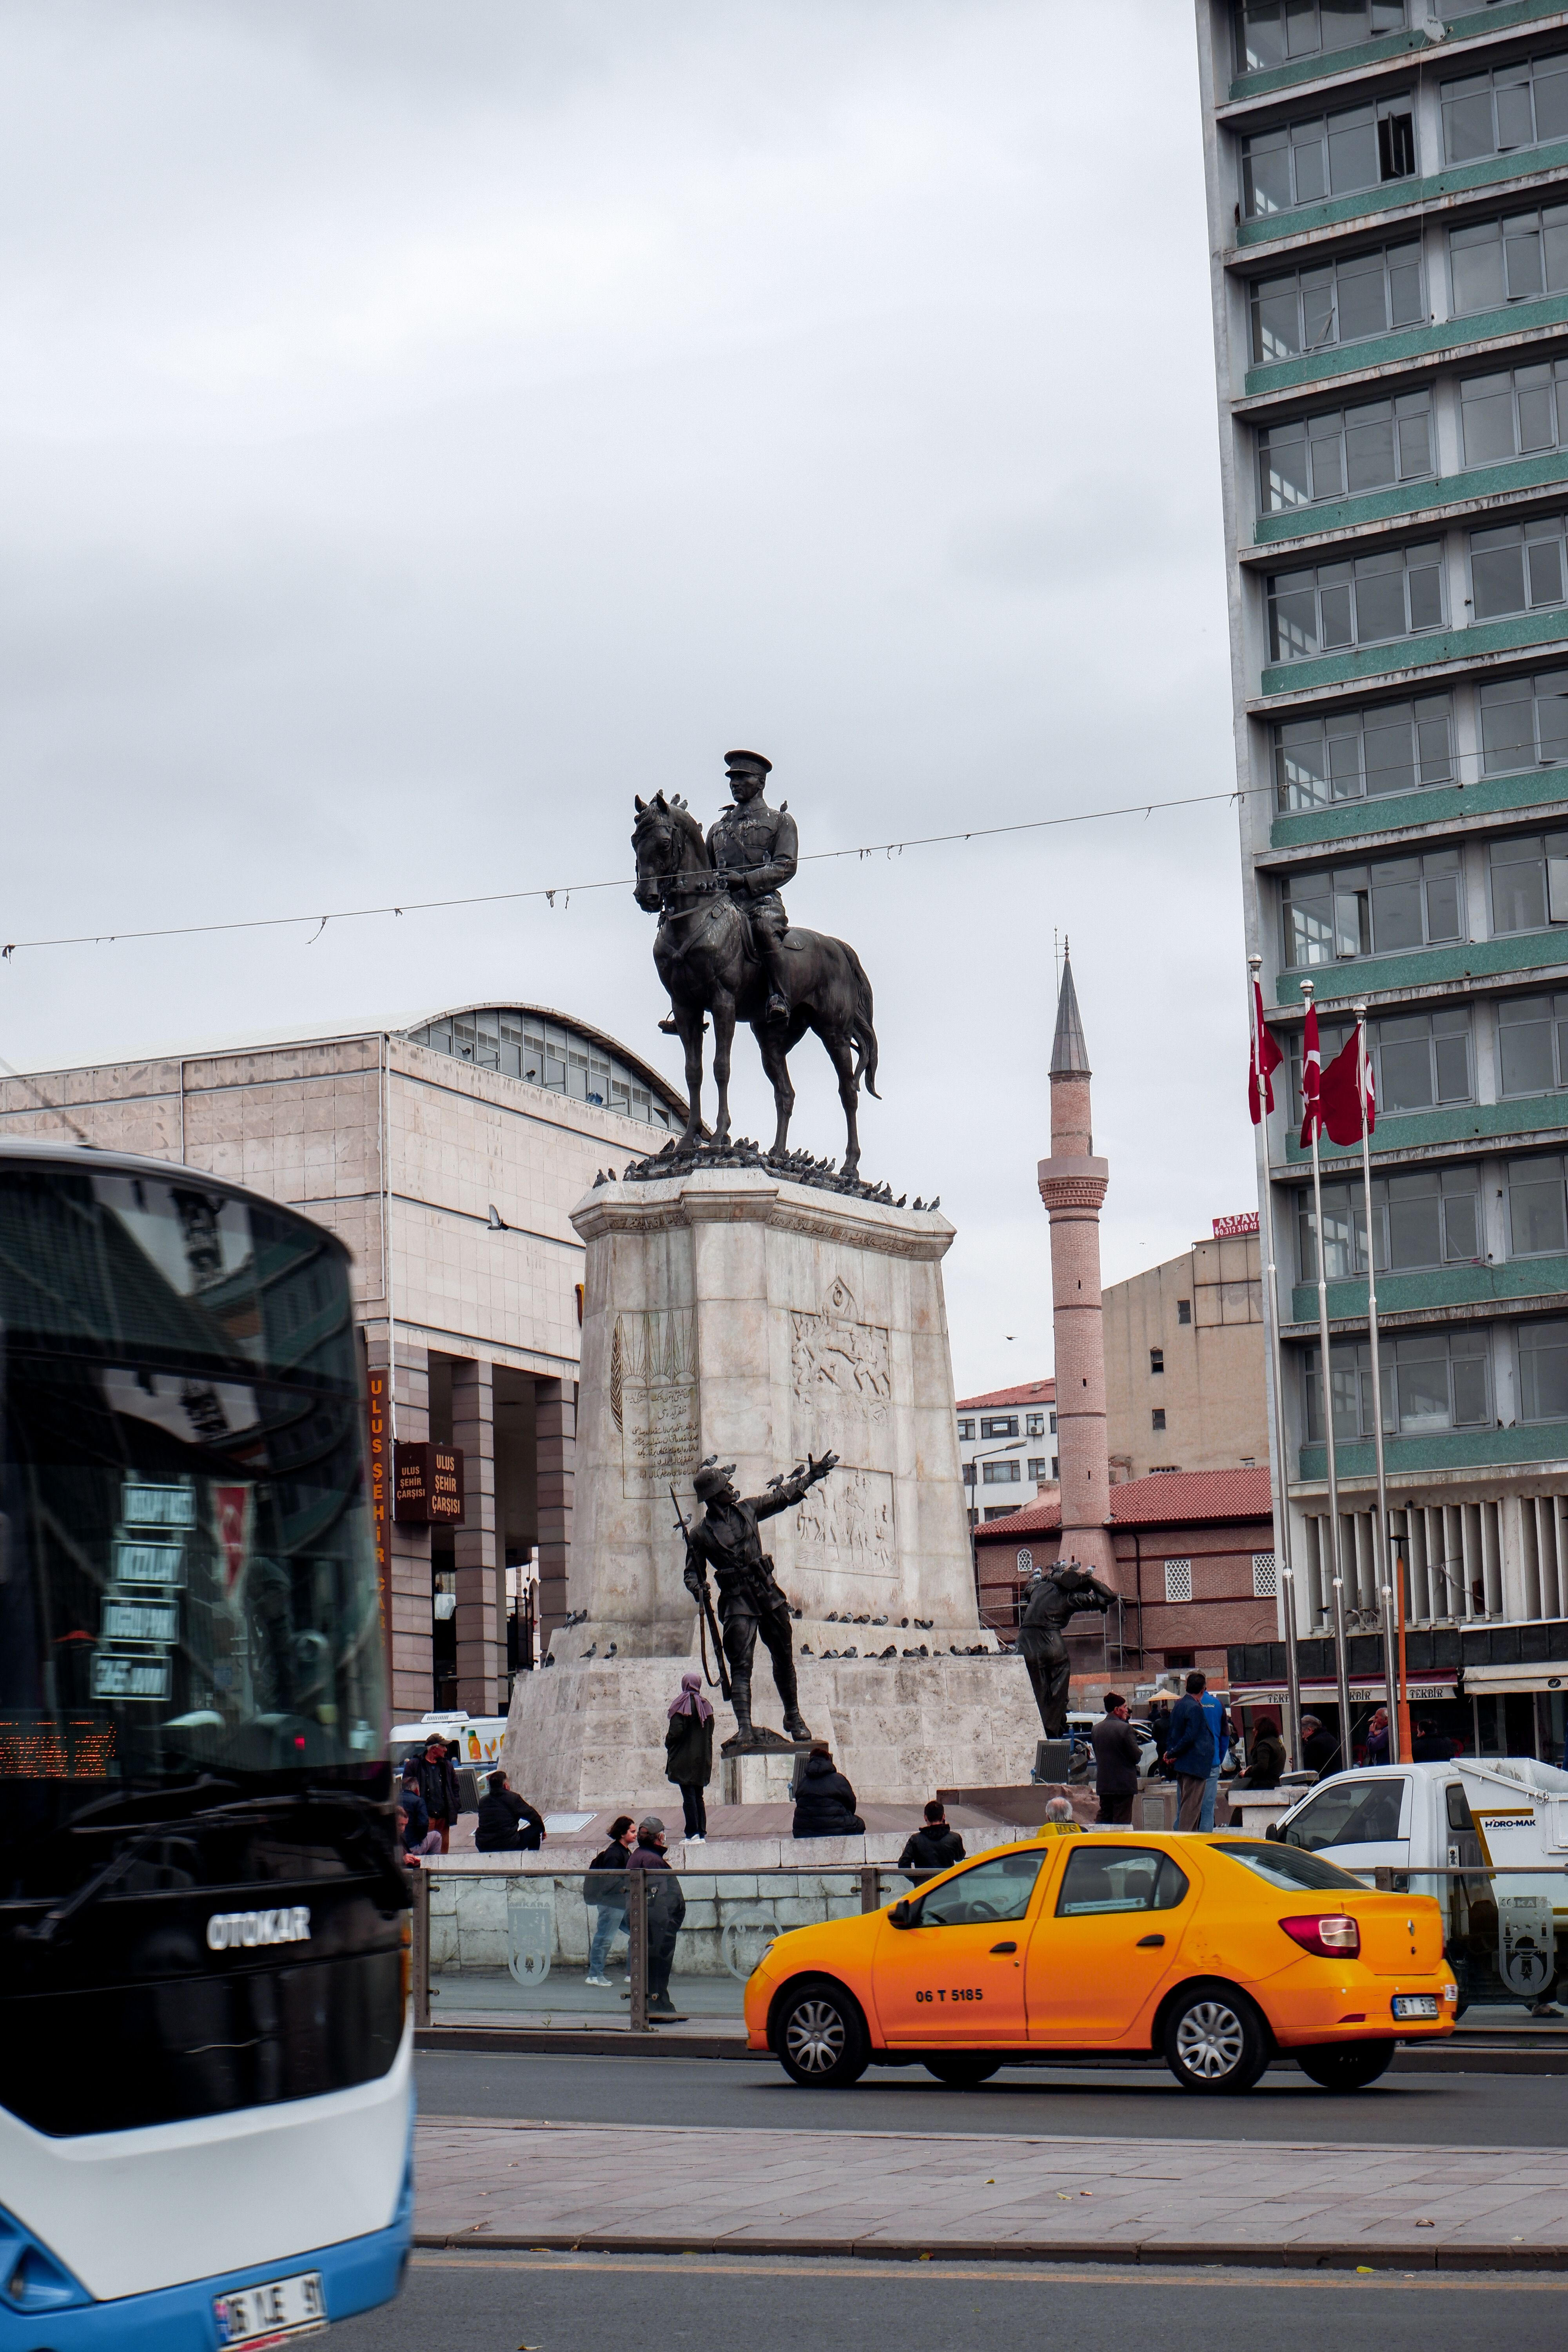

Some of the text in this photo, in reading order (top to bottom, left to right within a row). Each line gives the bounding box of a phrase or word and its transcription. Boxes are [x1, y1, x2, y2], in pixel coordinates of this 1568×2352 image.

[1220, 1226, 1236, 1235] 0.312
[1238, 1224, 1248, 1232] 310
[371, 1379, 383, 1453] ULUS
[402, 1466, 420, 1475] ULUS
[436, 1454, 454, 1472] ULUS
[400, 1476, 421, 1489] ŞEHİR
[435, 1474, 456, 1493] ŞEHİR
[397, 1488, 425, 1501] ÇARŞISI
[432, 1495, 460, 1516] ÇARŞISI
[206, 1907, 311, 1950] OTOKAR
[916, 1988, 983, 2002] 06 T 5185
